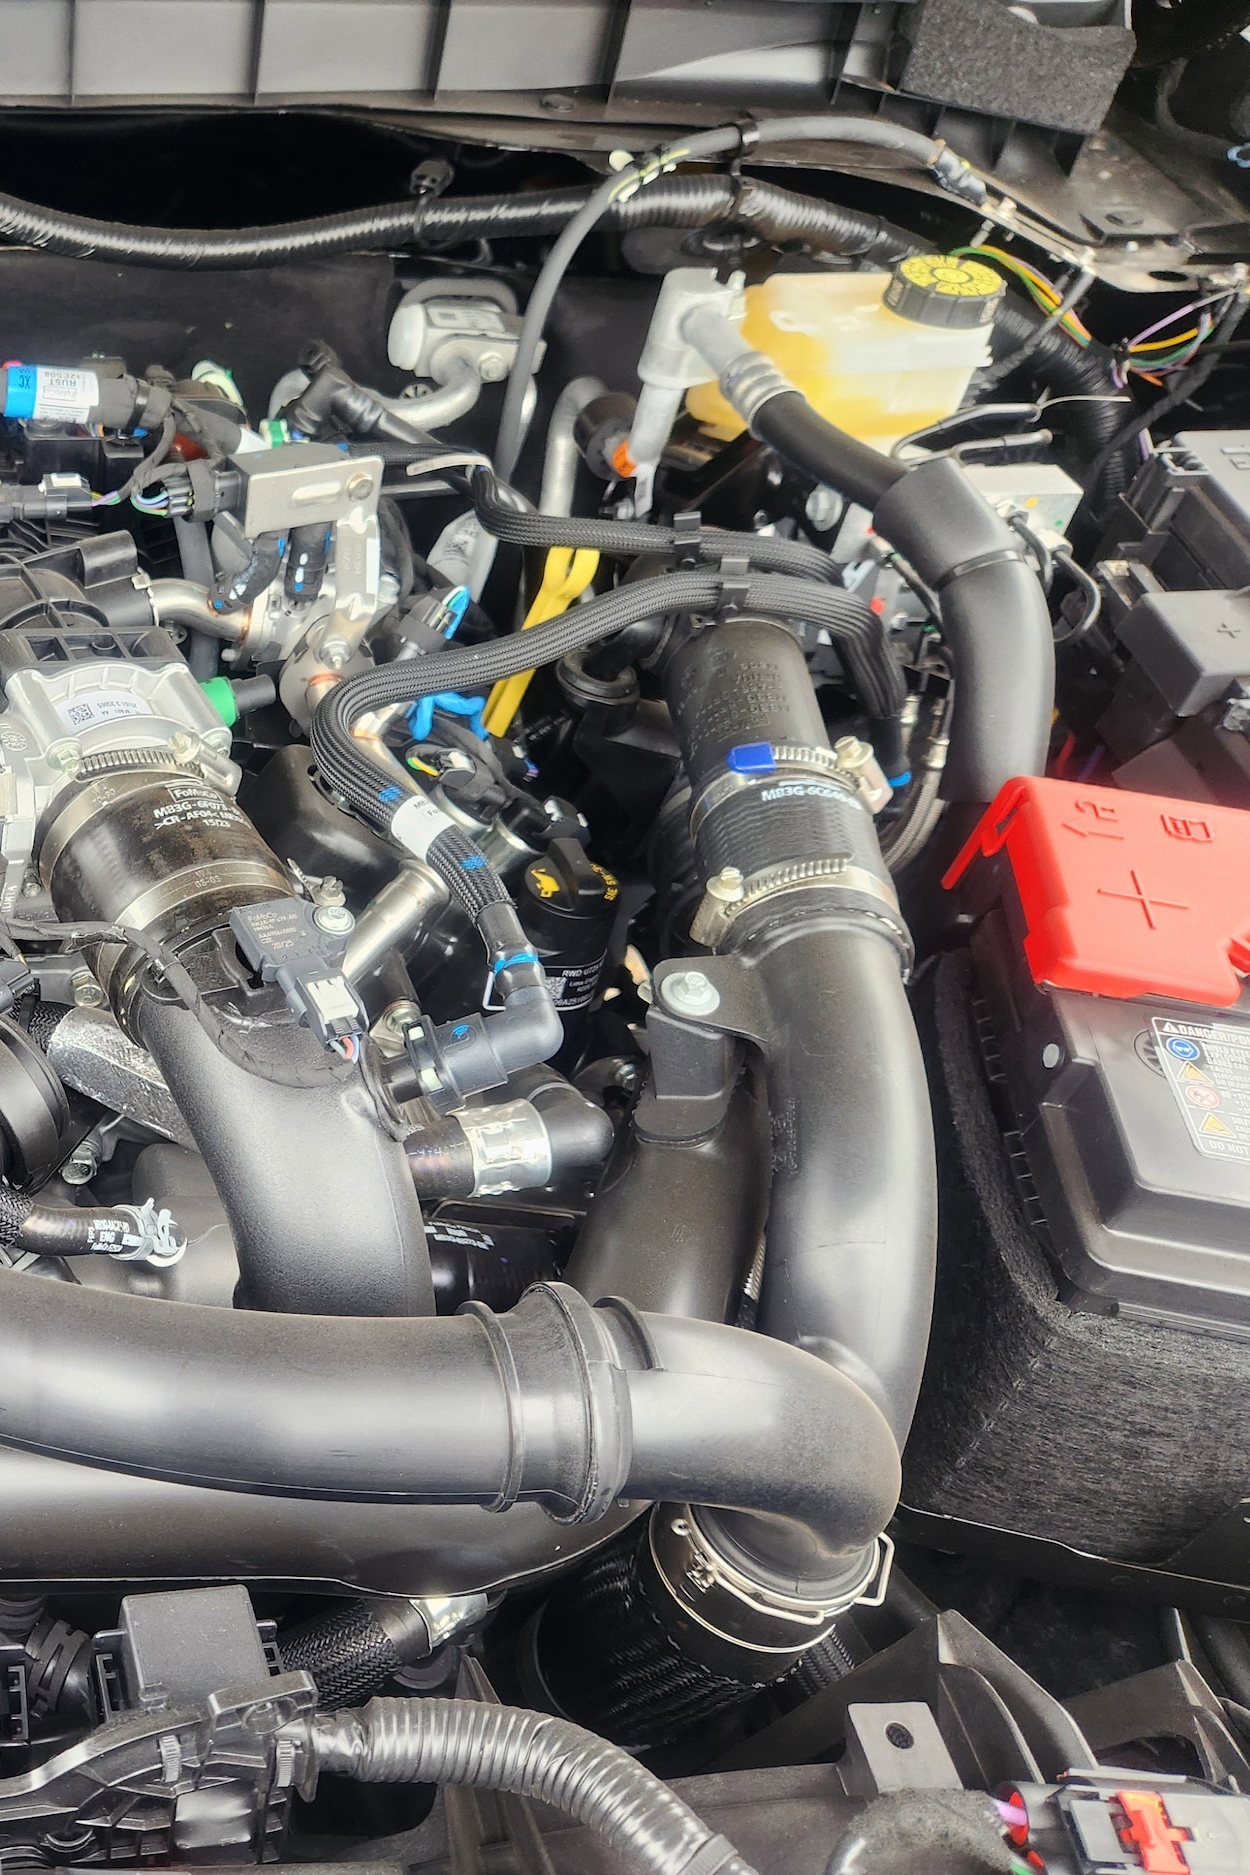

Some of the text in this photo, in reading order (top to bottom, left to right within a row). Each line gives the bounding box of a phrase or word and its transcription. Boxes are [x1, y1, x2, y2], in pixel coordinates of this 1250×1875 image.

[172, 788, 218, 800] FoMoCo
[246, 911, 278, 922] FoMoCo
[1209, 1139, 1227, 1151] DO
